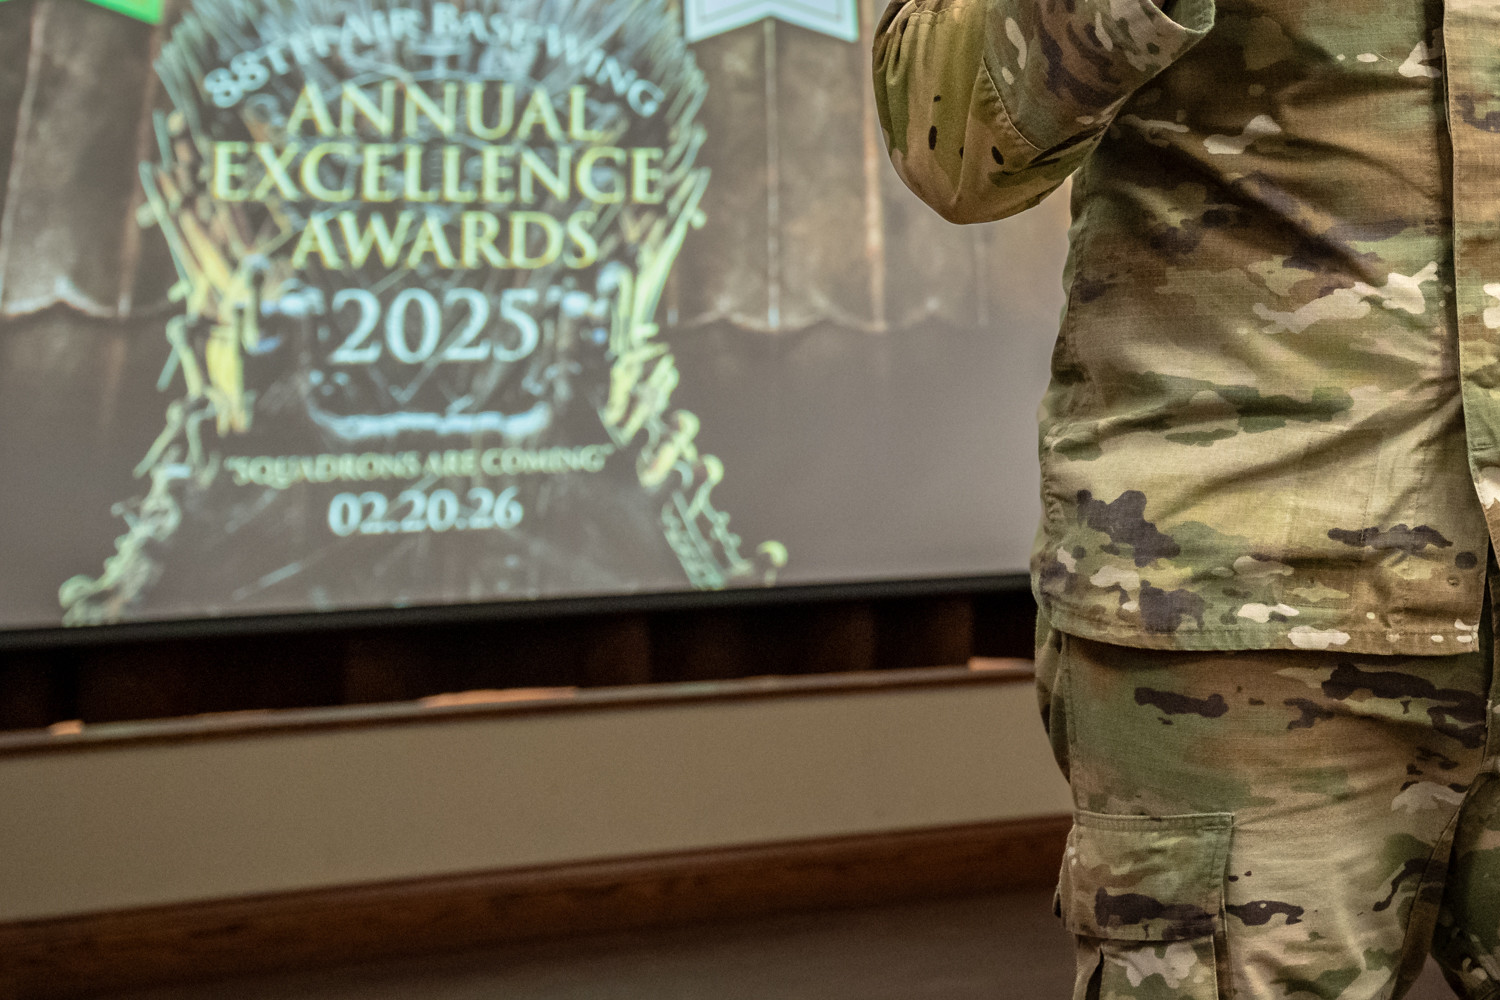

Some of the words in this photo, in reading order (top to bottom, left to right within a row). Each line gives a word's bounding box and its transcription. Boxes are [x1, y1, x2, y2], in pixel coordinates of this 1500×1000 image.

[342, 6, 425, 47] AIR
[546, 22, 665, 118] WING
[287, 80, 601, 141] ANNUAL
[213, 140, 664, 204] EXCELLENCE
[290, 209, 599, 270] AWARDS
[328, 286, 540, 365] 2025
[422, 448, 478, 477] ARE
[328, 485, 525, 538] 02.20.26
